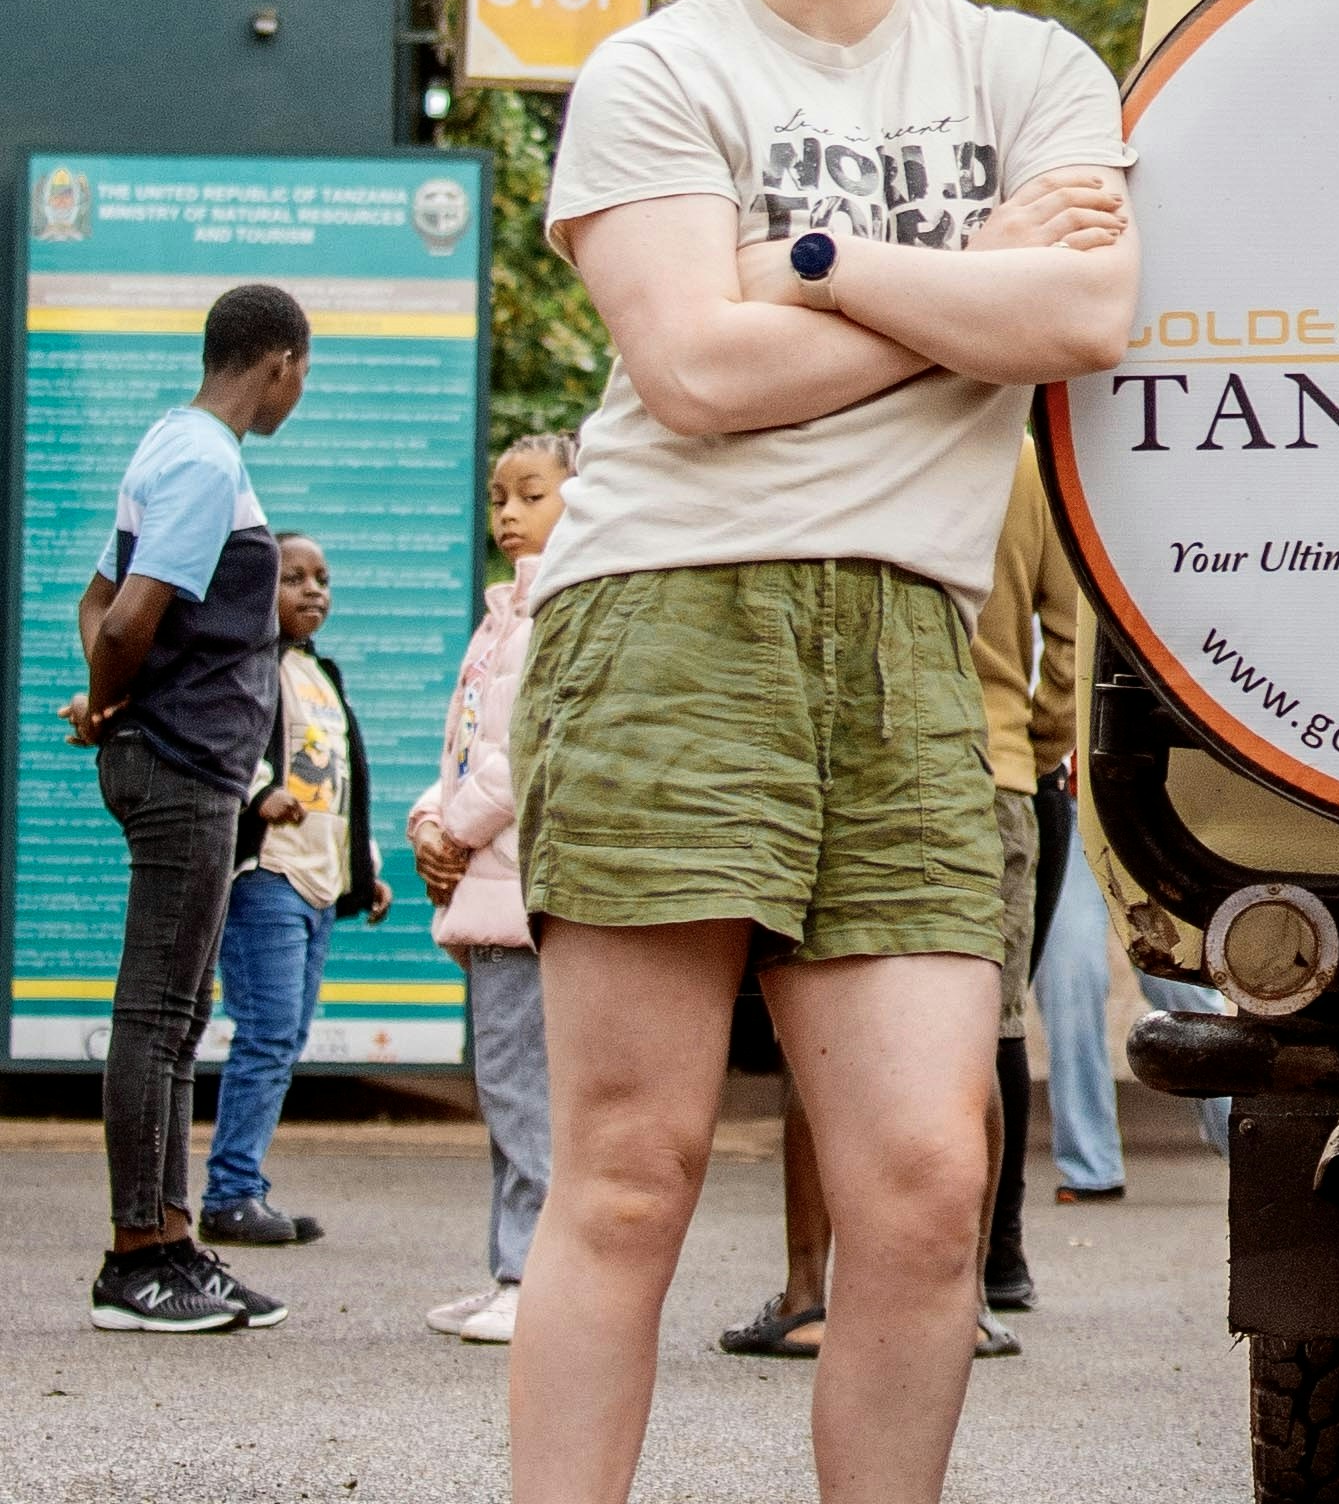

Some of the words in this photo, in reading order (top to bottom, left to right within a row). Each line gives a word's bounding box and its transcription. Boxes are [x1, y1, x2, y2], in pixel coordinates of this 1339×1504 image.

[98, 184, 130, 200] THE
[135, 184, 198, 201] UNITED
[203, 186, 288, 203] REPUBLIC
[292, 187, 315, 202] OF
[183, 206, 206, 221] OF
[1170, 542, 1248, 574] Your
